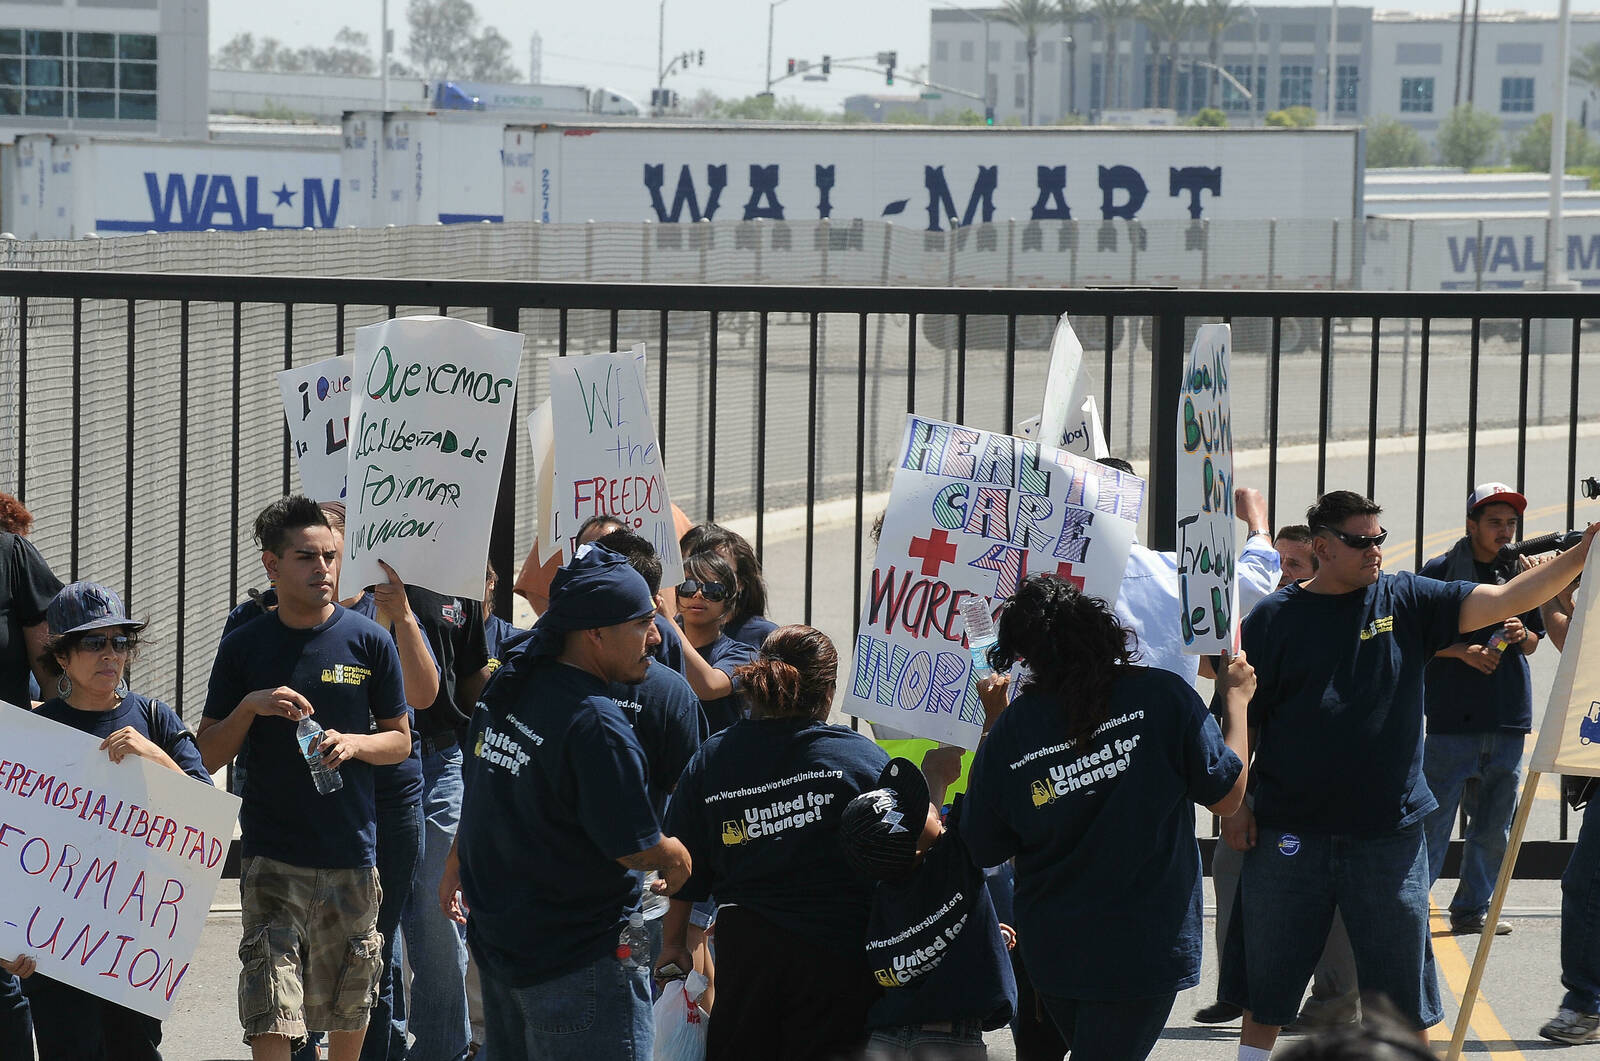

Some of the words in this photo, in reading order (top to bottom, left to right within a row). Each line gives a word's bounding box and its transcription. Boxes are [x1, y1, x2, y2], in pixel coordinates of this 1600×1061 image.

[605, 434, 657, 469] the
[902, 418, 1145, 523] HEALTH
[932, 482, 1095, 564] CARE
[1049, 743, 1114, 782] United
[1114, 734, 1141, 756] for
[1054, 752, 1131, 796] Change!
[744, 796, 805, 824] United
[806, 791, 835, 808] for
[747, 806, 822, 838] Change!
[893, 935, 948, 971] United
